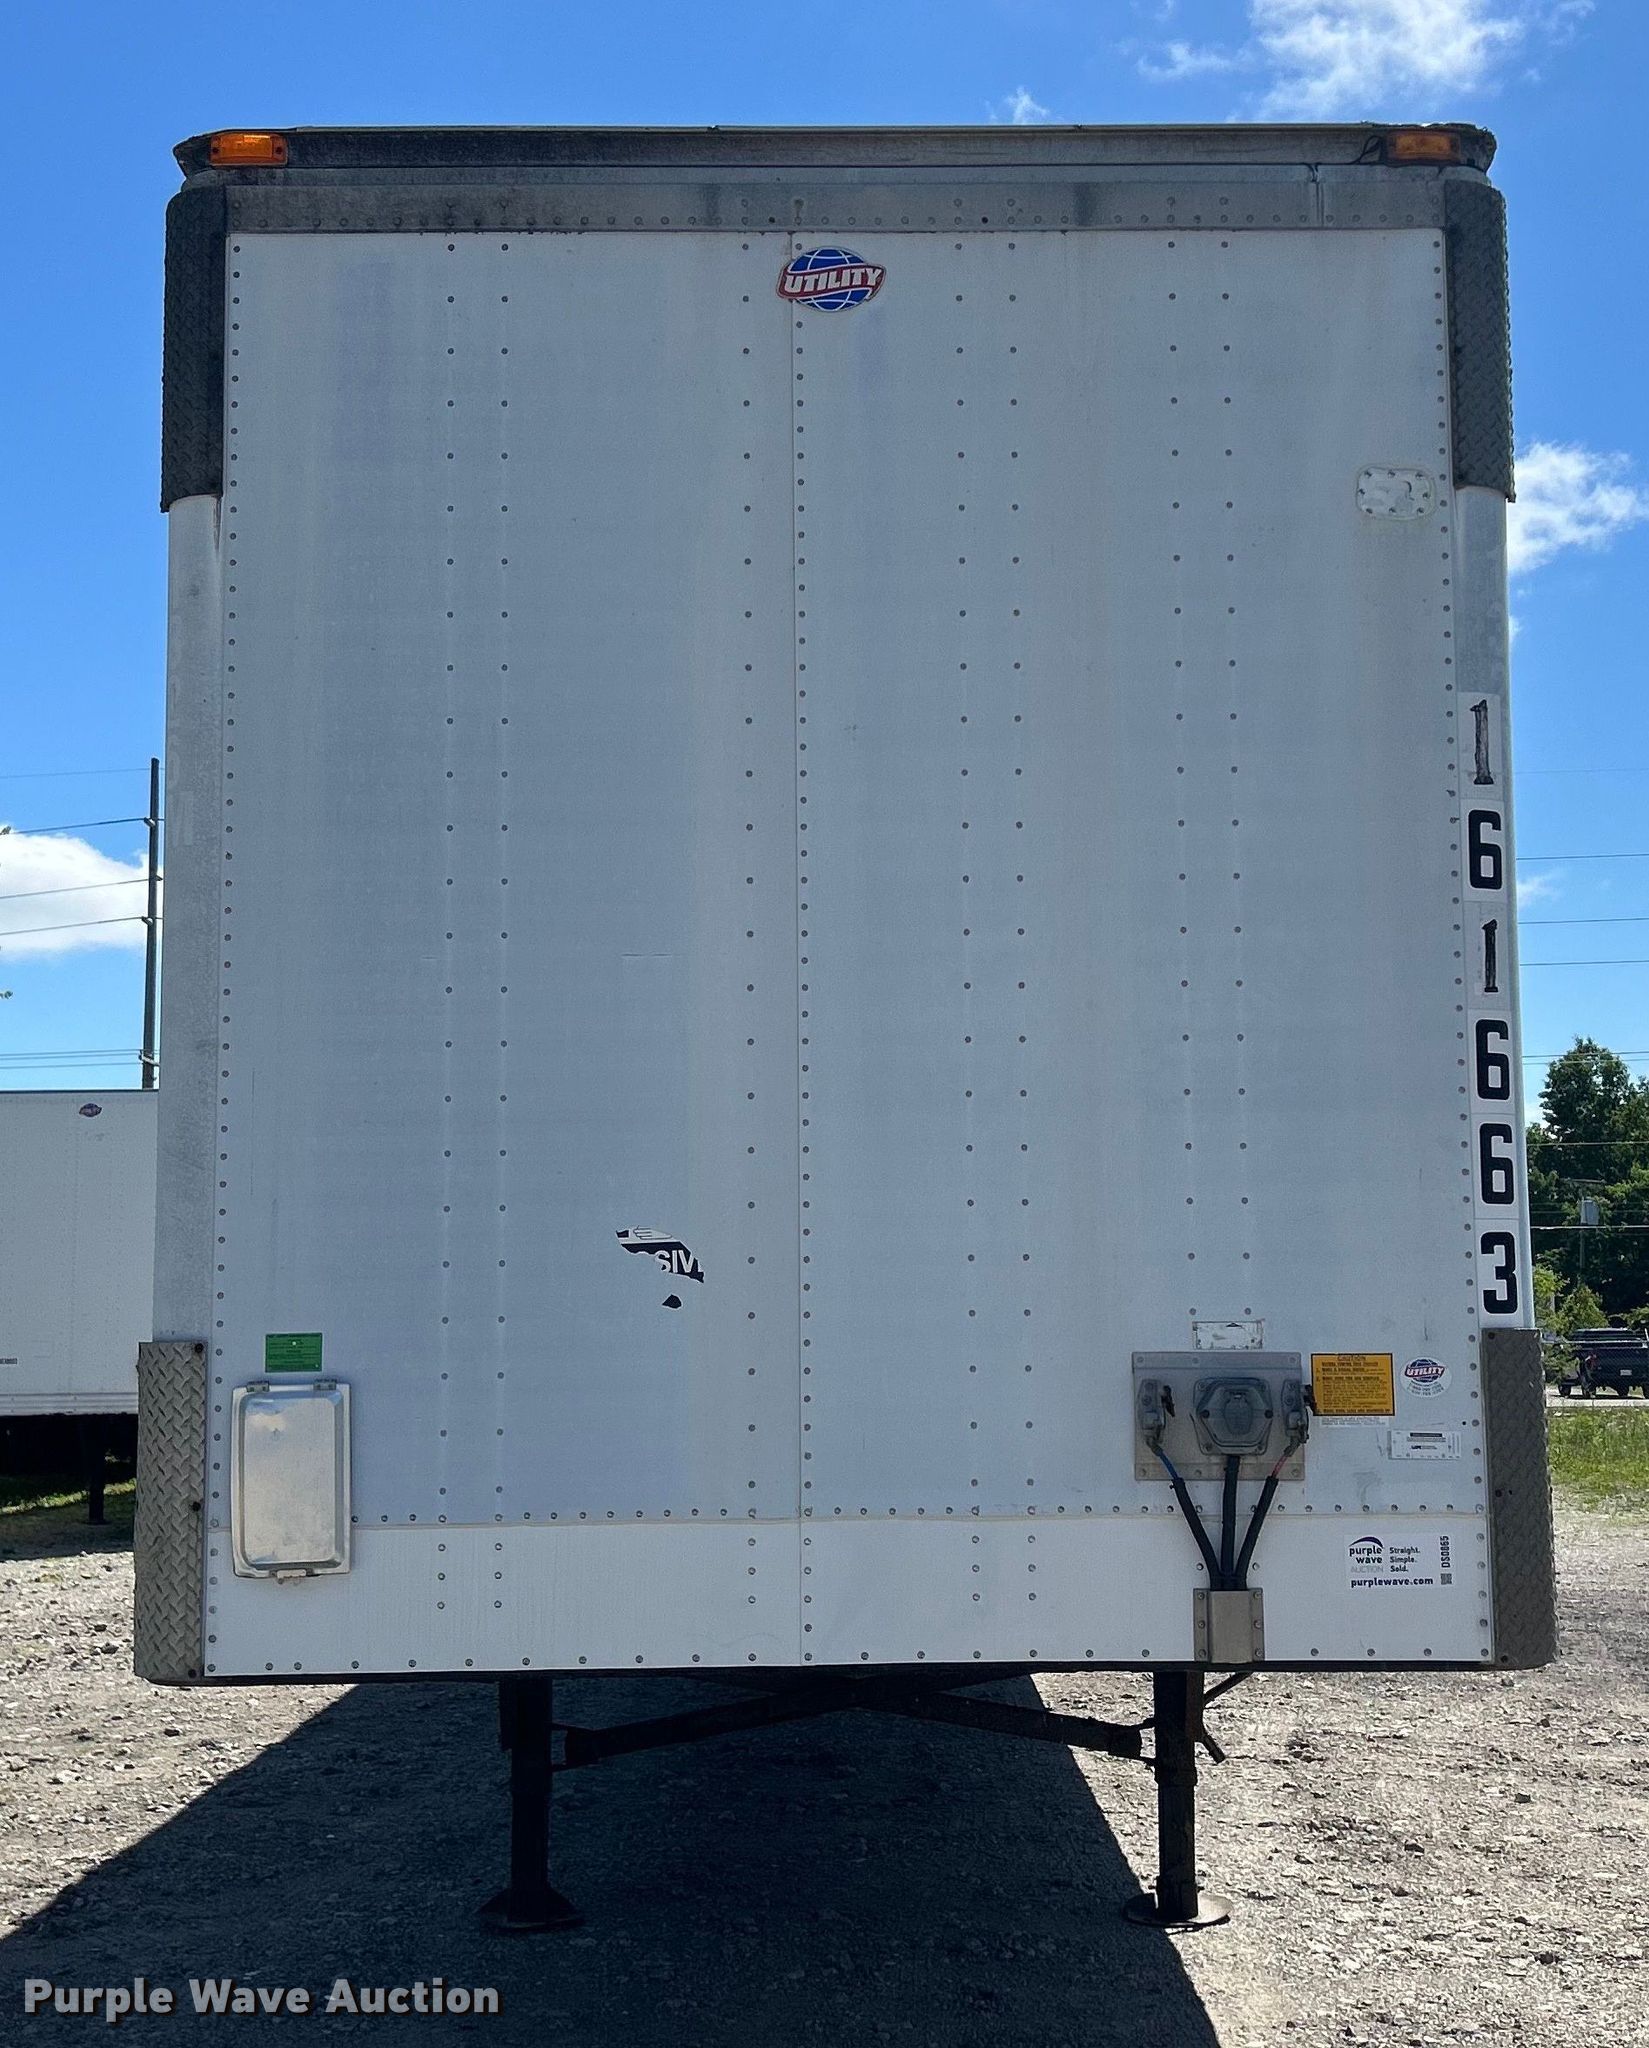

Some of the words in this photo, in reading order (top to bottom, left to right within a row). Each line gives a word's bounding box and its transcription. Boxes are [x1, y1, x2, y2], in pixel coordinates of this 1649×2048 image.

[784, 267, 882, 293] UTILITY
[1406, 1367, 1444, 1376] UTILITY
[1349, 1545, 1382, 1556] purple
[1389, 1546, 1420, 1555] Straight.
[1356, 1556, 1382, 1564] wave
[1389, 1556, 1417, 1565] Simple.
[1390, 1565, 1408, 1573] Sold.
[1351, 1577, 1433, 1588] purplewave.com
